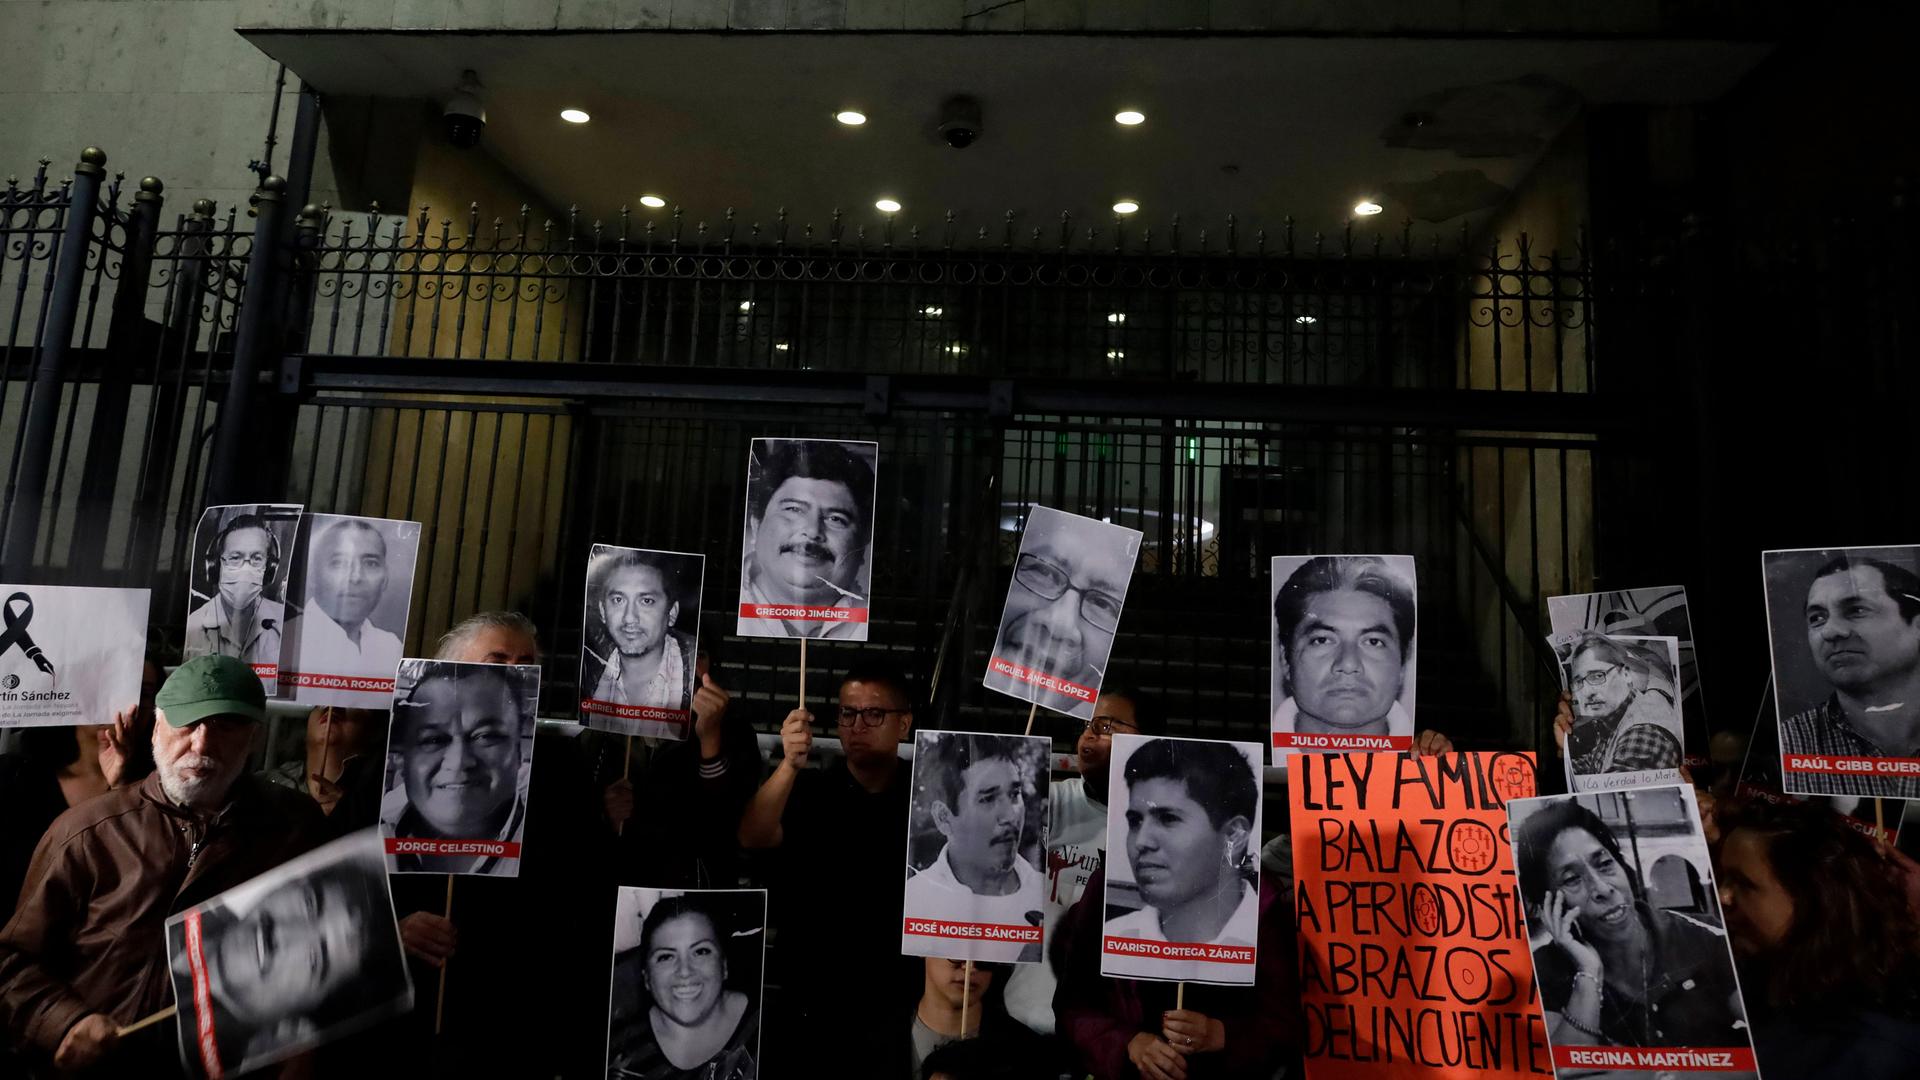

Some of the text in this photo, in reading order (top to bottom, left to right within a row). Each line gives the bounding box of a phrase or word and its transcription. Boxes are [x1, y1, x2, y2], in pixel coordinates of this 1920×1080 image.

[755, 607, 850, 619] GREGORIO JIMÉNEZ
[252, 666, 276, 675] ORES
[279, 675, 310, 685] ERGIO
[312, 677, 348, 687] LANDA
[994, 662, 1090, 699] MIGUEL ÁNGEL LÓPEZ
[21, 690, 70, 700] Sánchez
[581, 701, 687, 720] GABRIEL HUGE CÓRDOVA
[1290, 735, 1392, 748] JULIO VALDIVIA
[1791, 756, 1832, 770] RAÚL
[1835, 760, 1873, 771] GIBB
[1302, 752, 1537, 810] LEY AMLO
[396, 841, 504, 854] JORGE CELESTINO
[1075, 875, 1089, 886] PE
[1296, 880, 1321, 933] A
[909, 921, 1040, 940] JOSÉ MOISÉS SÁNCHEZ
[1107, 941, 1251, 960] EVARISTO ORTEGA ZÁRATE
[1300, 941, 1517, 1005] ABRAZOS
[1304, 1003, 1553, 1075] DELINCUENTE
[1570, 1050, 1734, 1067] REGINA MARTÍNEZ
